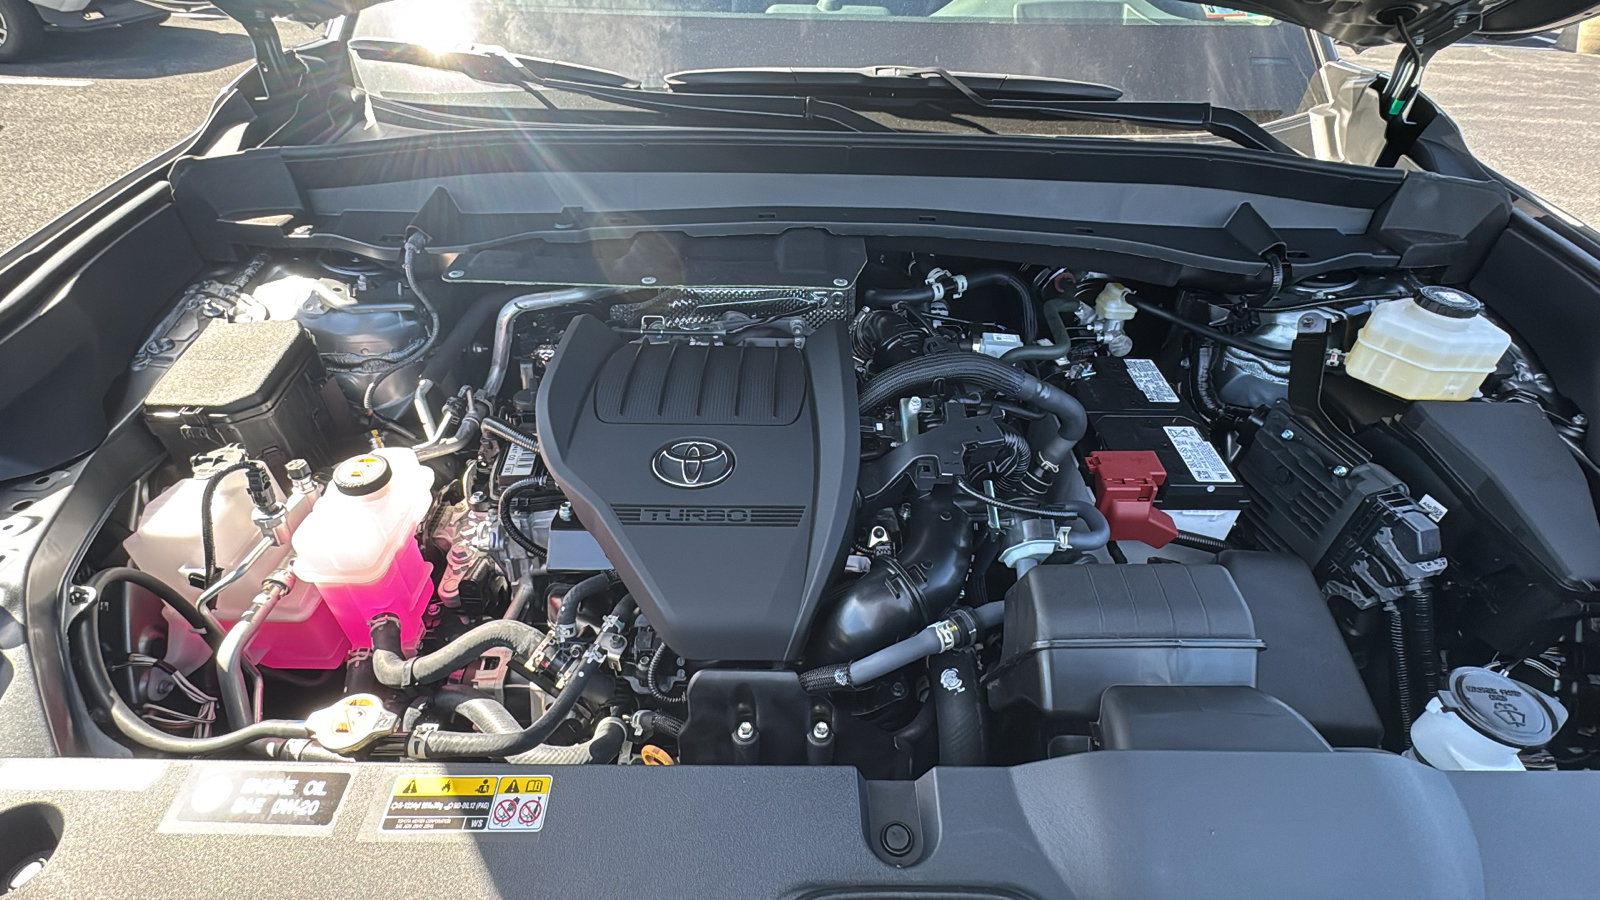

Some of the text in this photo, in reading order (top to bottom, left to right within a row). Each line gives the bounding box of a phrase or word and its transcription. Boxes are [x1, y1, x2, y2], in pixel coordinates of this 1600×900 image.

[643, 507, 749, 523] TURBO
[240, 777, 327, 796] ENGINE OIL
[231, 796, 320, 816] SAE 0W-20
[470, 819, 484, 828] WS
